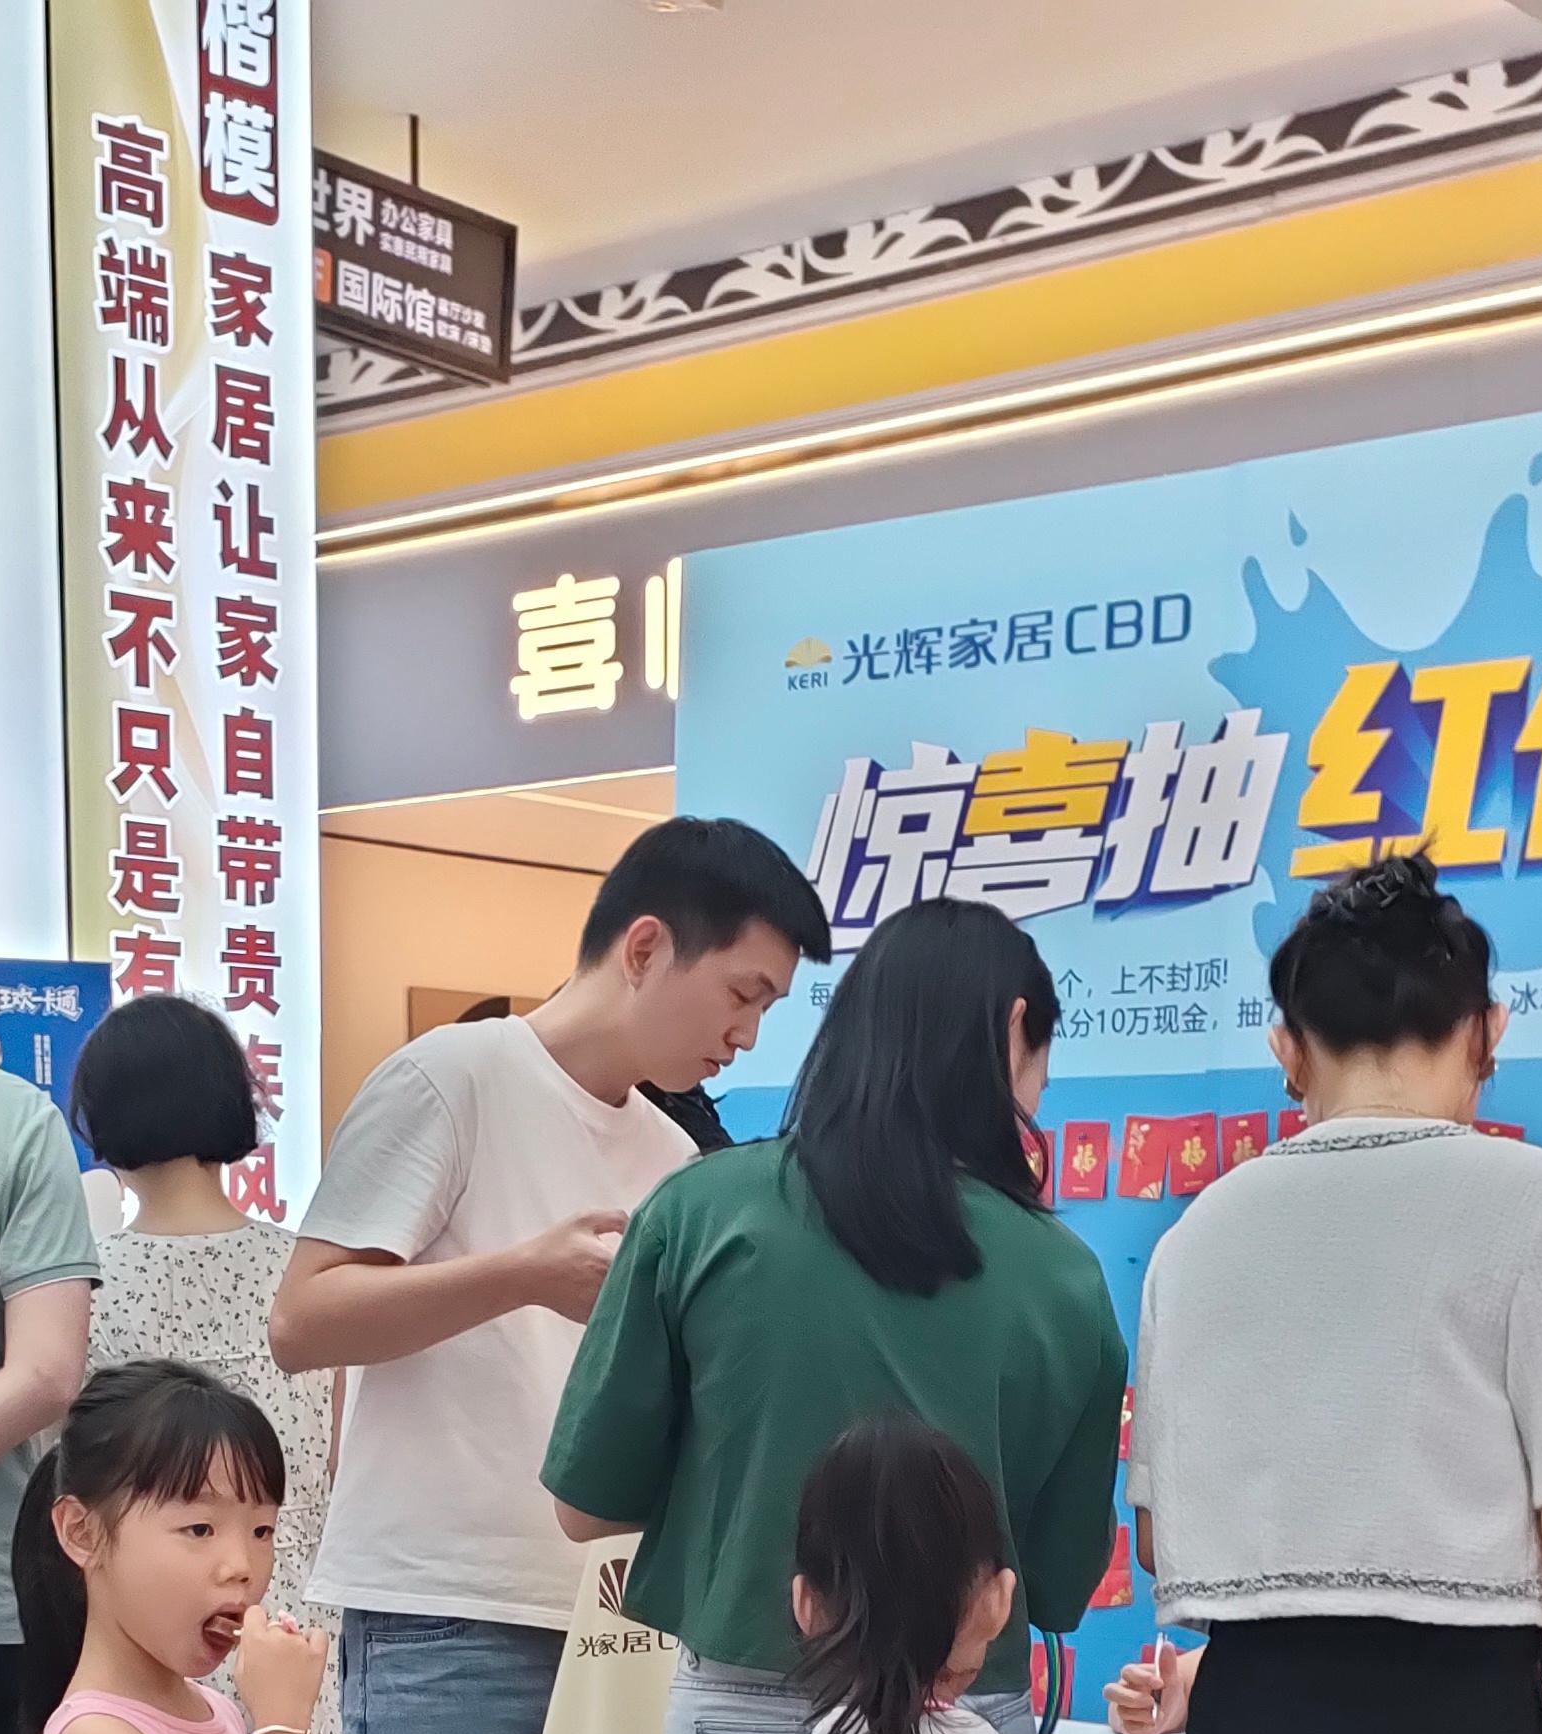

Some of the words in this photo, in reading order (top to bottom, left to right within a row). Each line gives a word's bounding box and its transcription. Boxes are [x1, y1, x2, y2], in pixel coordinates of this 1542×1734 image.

[380, 197, 454, 250] 办公家具
[337, 259, 436, 338] 国际馆
[842, 592, 1192, 686] 光辉家居CBD
[787, 671, 829, 691] KERI
